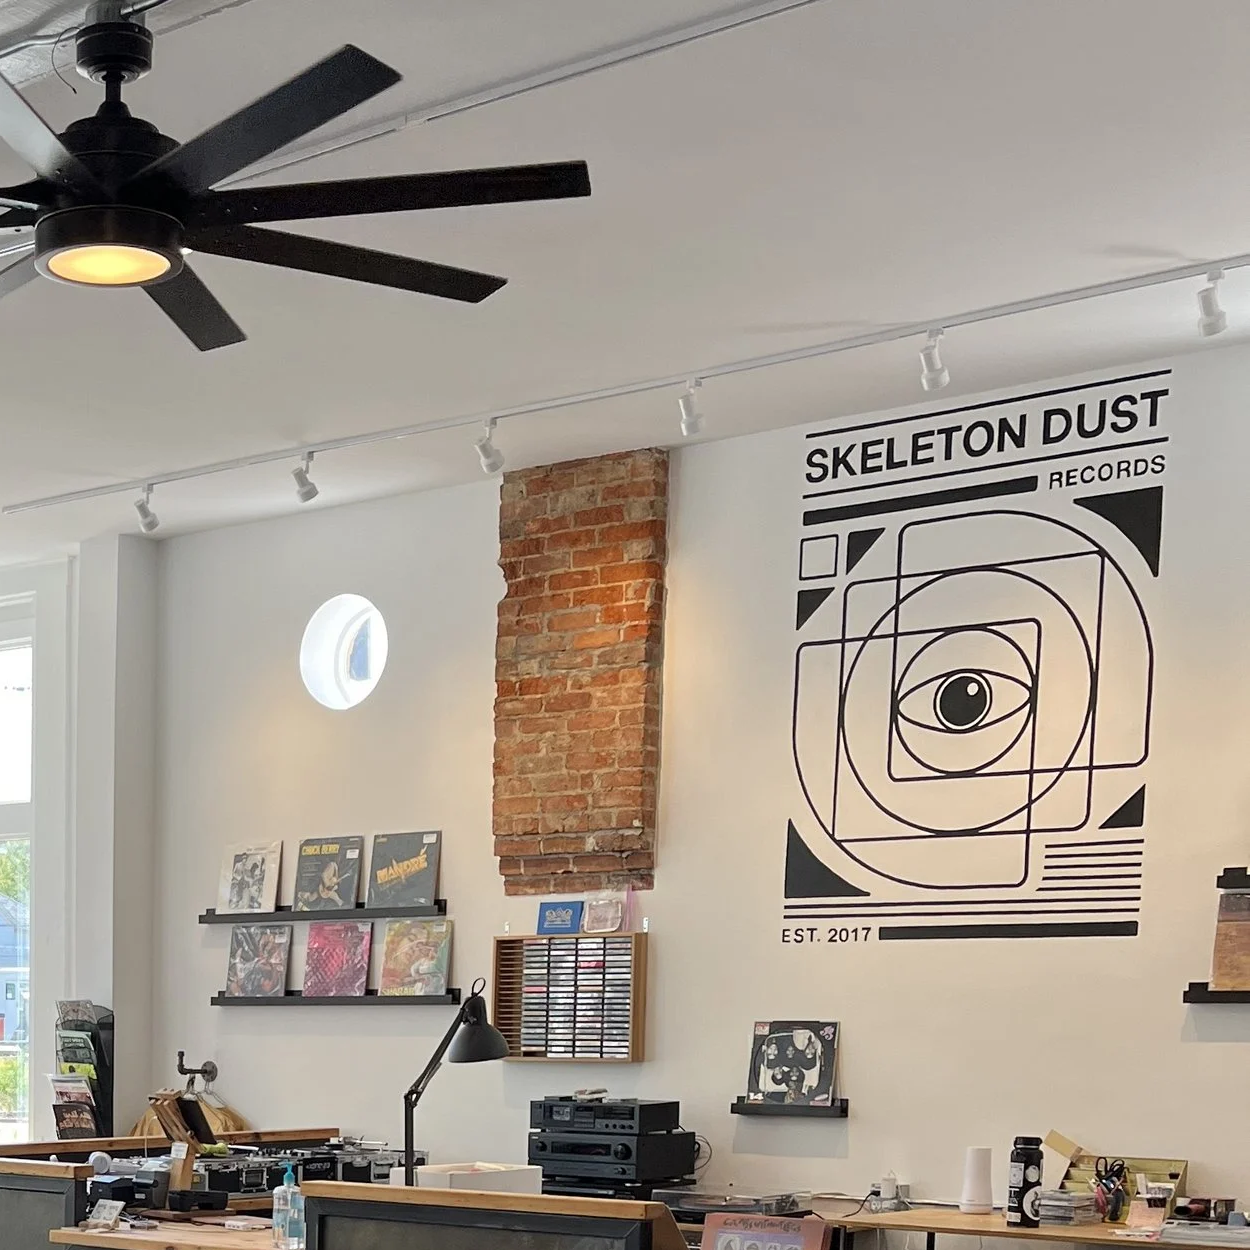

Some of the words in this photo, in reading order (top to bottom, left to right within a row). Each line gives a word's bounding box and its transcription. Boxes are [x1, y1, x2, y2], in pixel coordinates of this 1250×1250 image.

[805, 413, 1028, 483] SKELETON
[1040, 388, 1169, 446] DUST
[1048, 455, 1167, 489] RECORDS
[302, 845, 321, 856] CHUCK
[321, 843, 340, 855] BERRY
[781, 928, 821, 944] EST.
[827, 927, 871, 943] 2017
